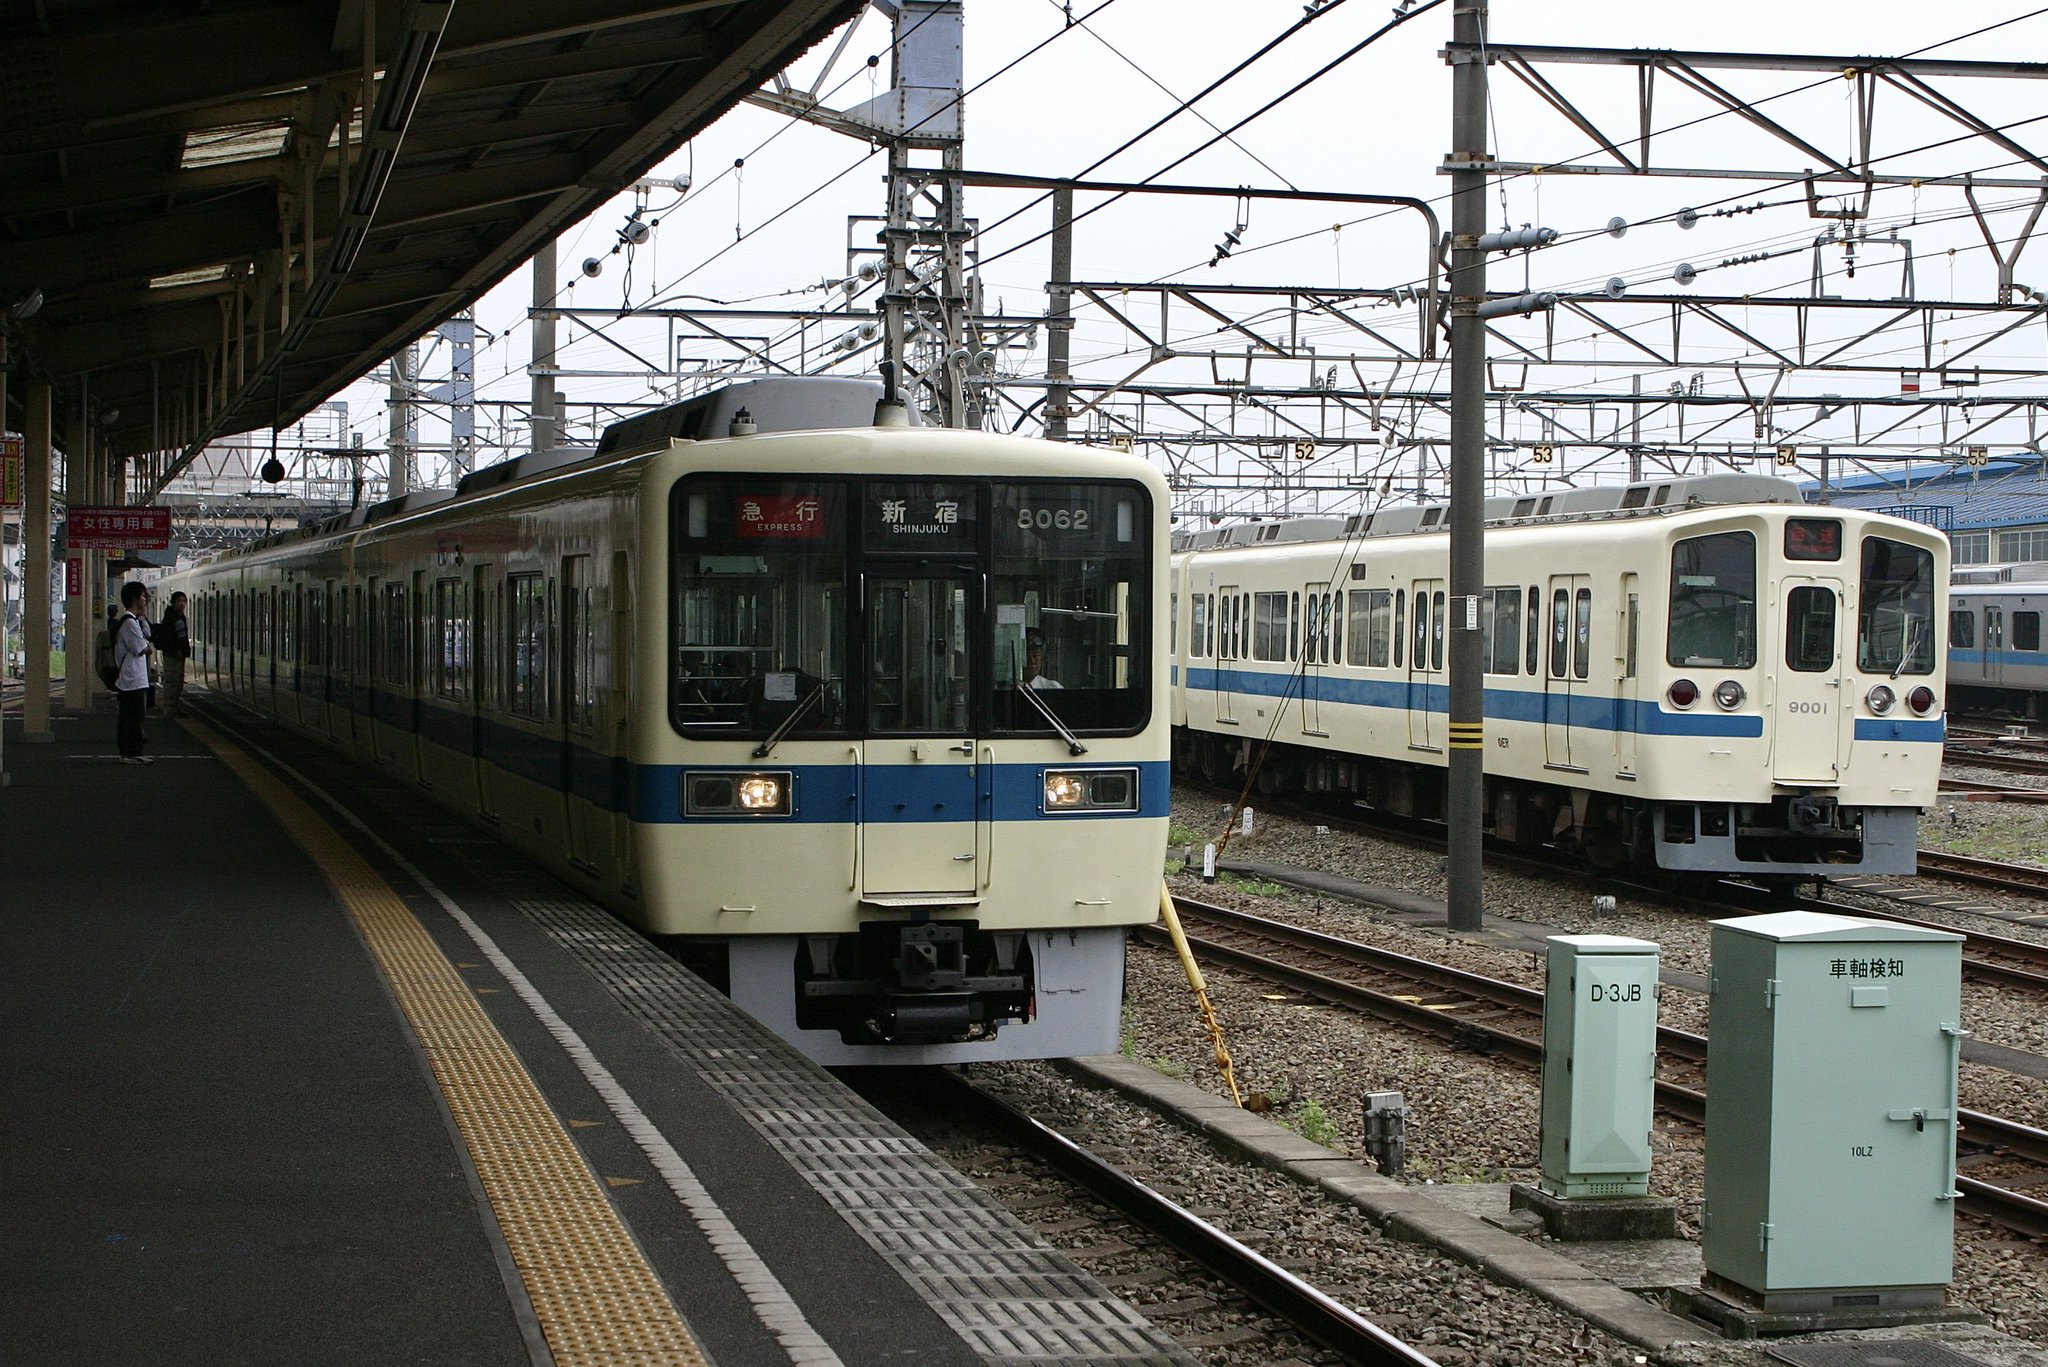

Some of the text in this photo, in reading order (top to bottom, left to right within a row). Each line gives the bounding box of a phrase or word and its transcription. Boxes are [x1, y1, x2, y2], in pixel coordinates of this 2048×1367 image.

[1295, 443, 1315, 460] 52
[1533, 446, 1553, 463] 53
[1777, 449, 1796, 466] 54
[1968, 449, 1988, 466] 55
[83, 516, 155, 530] 女性専用車
[757, 523, 802, 531] EXPRESS
[1017, 508, 1088, 530] 8062
[892, 524, 949, 534] SHINJUKU
[1789, 701, 1827, 715] 9001
[1829, 957, 1905, 979] 車軸検知
[1851, 1146, 1873, 1157] 10LZ
